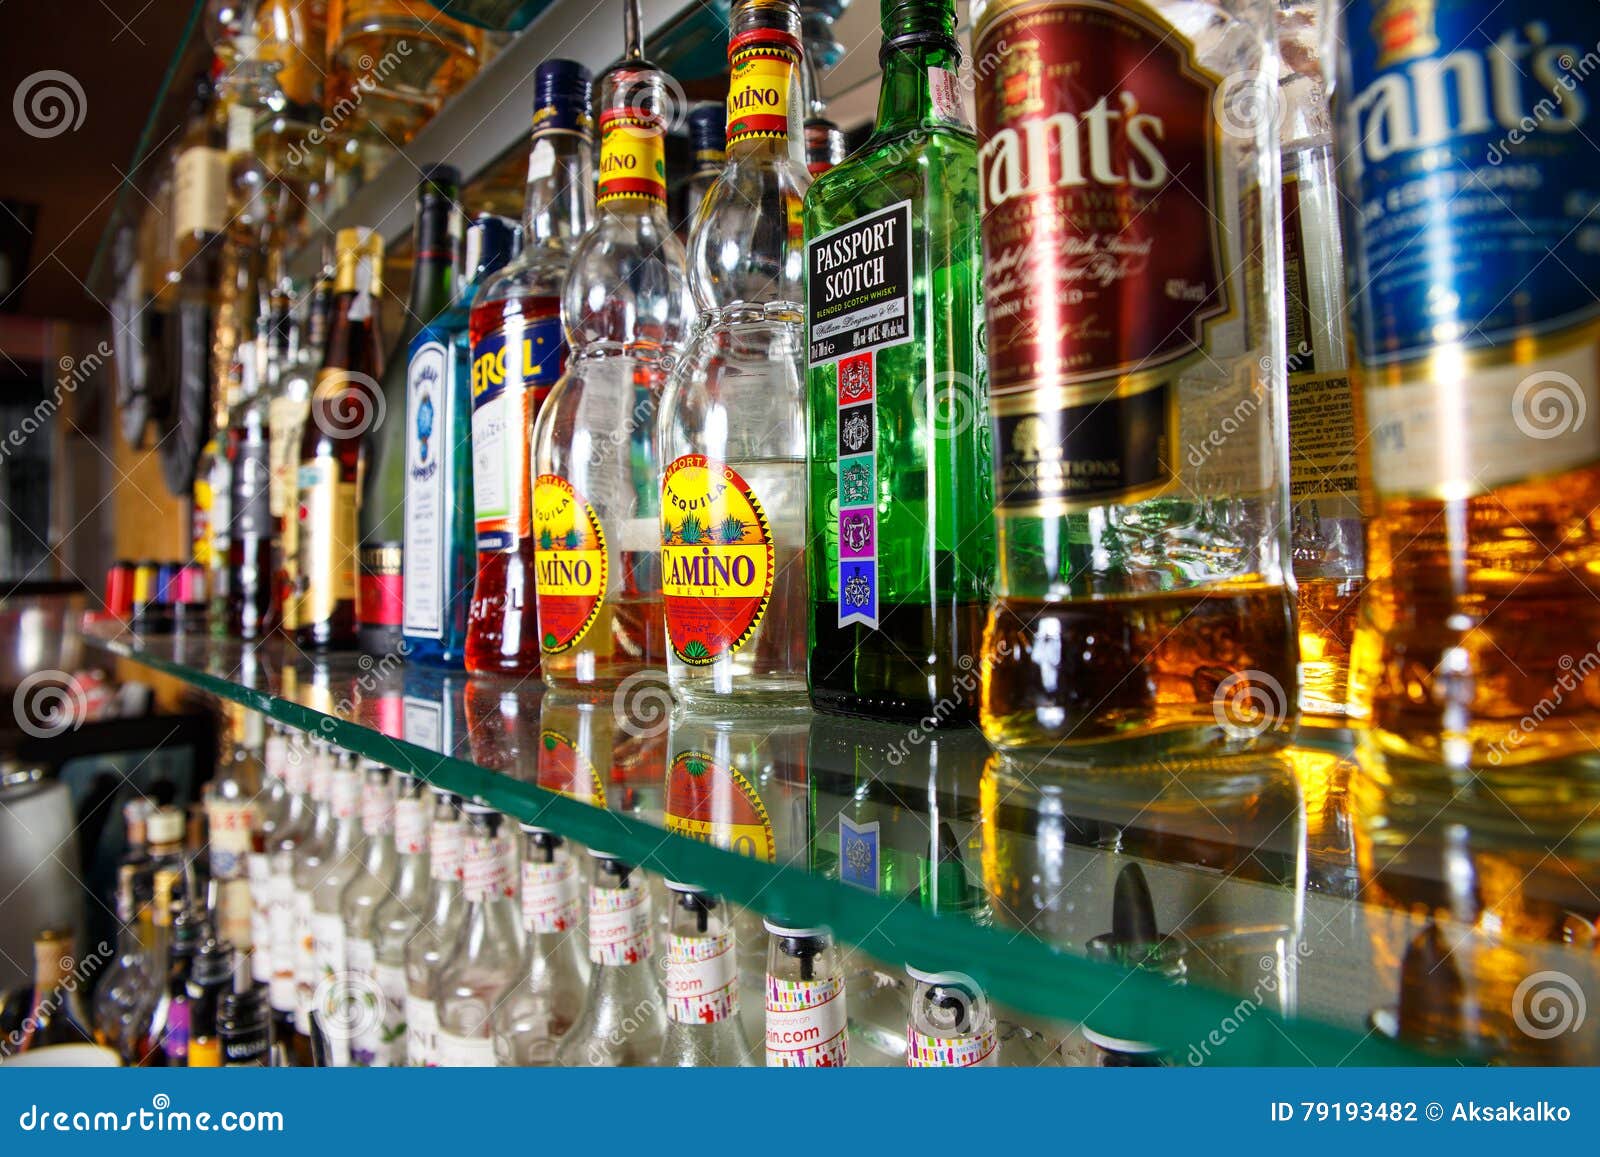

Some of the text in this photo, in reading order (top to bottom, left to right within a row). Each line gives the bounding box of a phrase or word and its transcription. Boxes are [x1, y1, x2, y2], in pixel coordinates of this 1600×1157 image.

[816, 217, 897, 274] PASSPORT
[825, 255, 885, 303] SCOTCH
[816, 285, 897, 319] BLENDED SCOTCH WHISKY
[663, 457, 734, 484] IMPORTAO
[666, 484, 728, 511] TEQUILA
